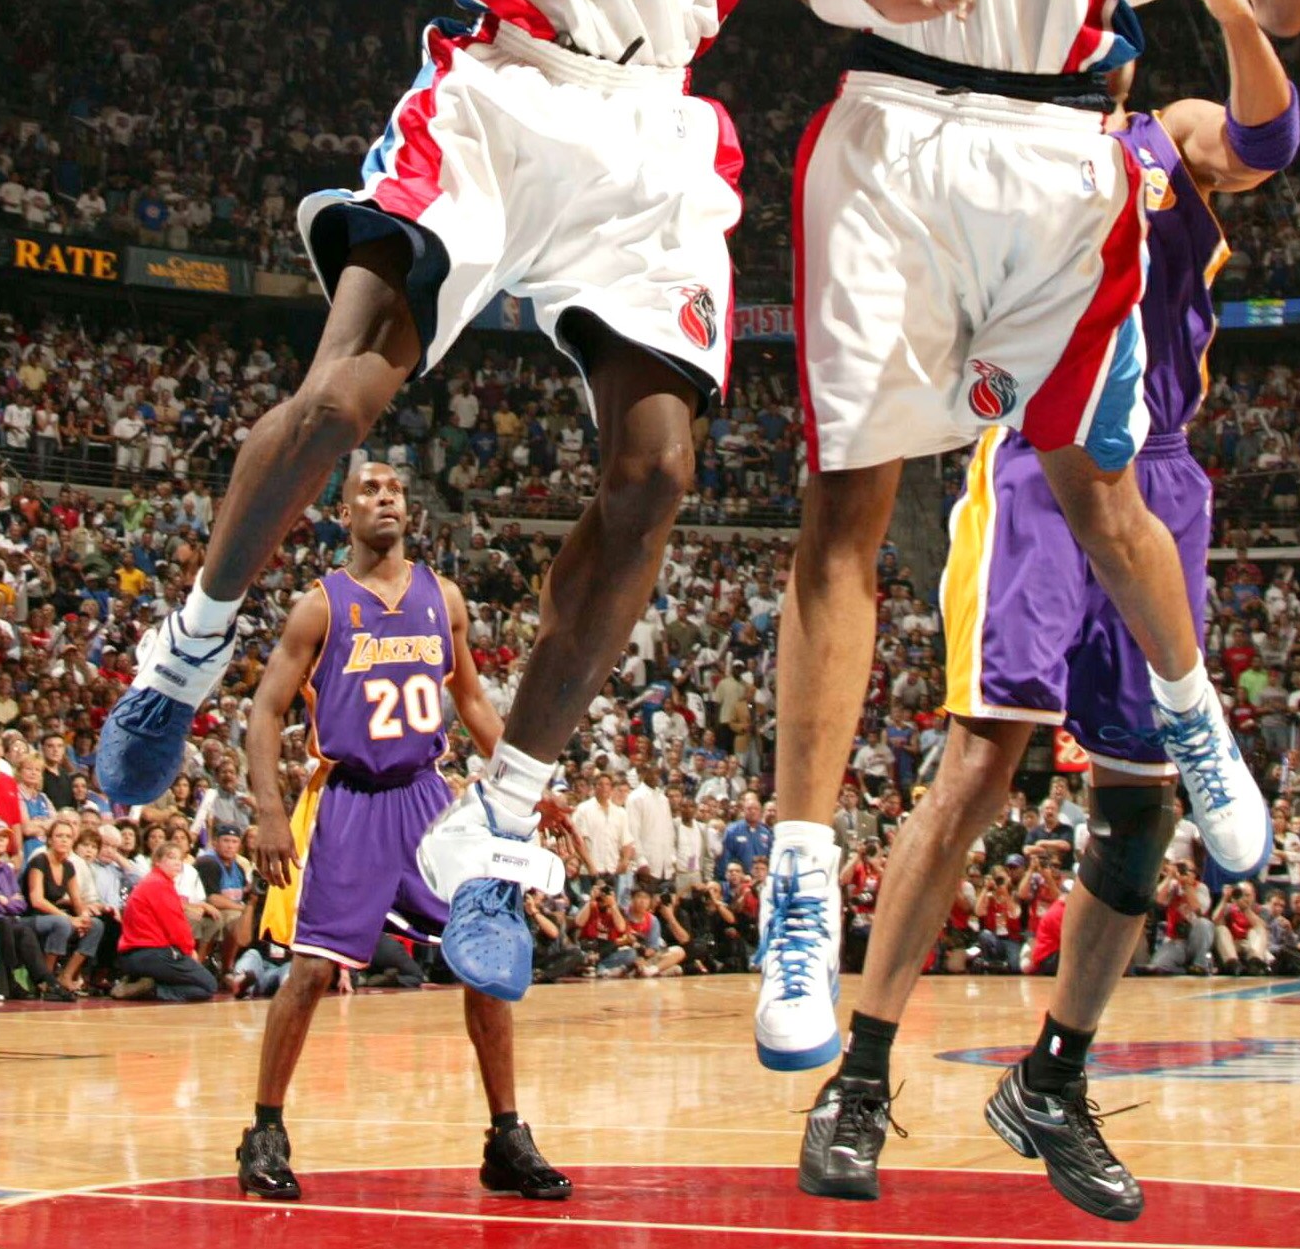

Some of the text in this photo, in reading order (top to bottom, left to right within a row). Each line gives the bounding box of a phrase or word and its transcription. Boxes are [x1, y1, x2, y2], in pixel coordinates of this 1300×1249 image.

[15, 240, 118, 281] RATE
[733, 304, 794, 341] PIST
[342, 632, 445, 675] LAKERS
[363, 673, 443, 741] 20
